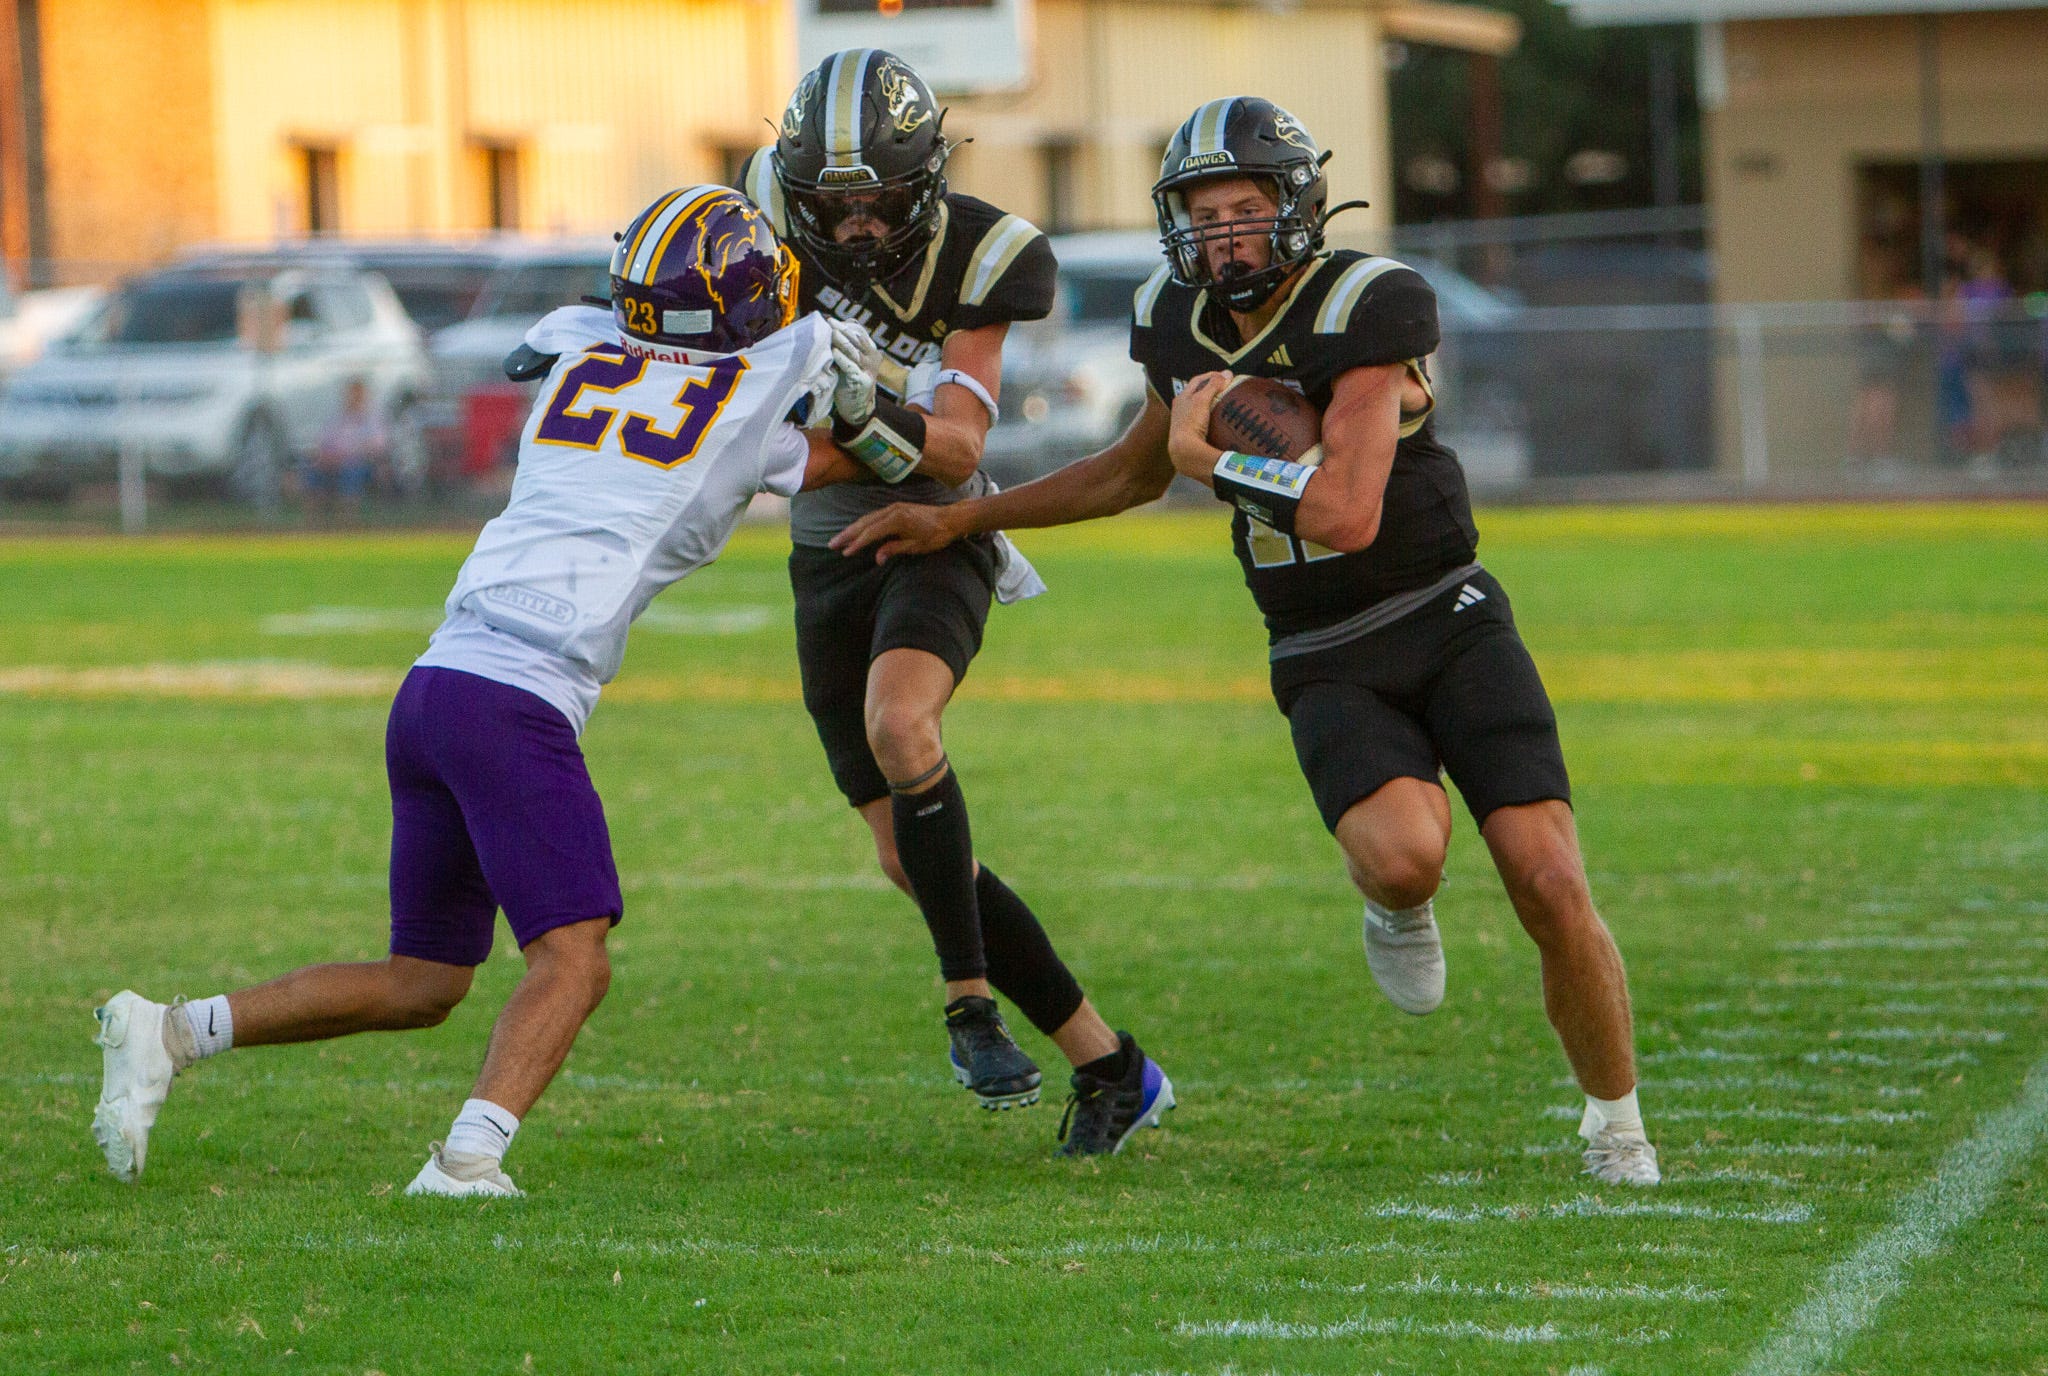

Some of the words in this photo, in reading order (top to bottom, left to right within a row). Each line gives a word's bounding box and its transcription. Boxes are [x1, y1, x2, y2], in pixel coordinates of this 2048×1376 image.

[1185, 152, 1227, 169] DAWGS
[824, 171, 868, 183] DAWGS
[624, 297, 658, 334] 23
[533, 341, 751, 471] 23
